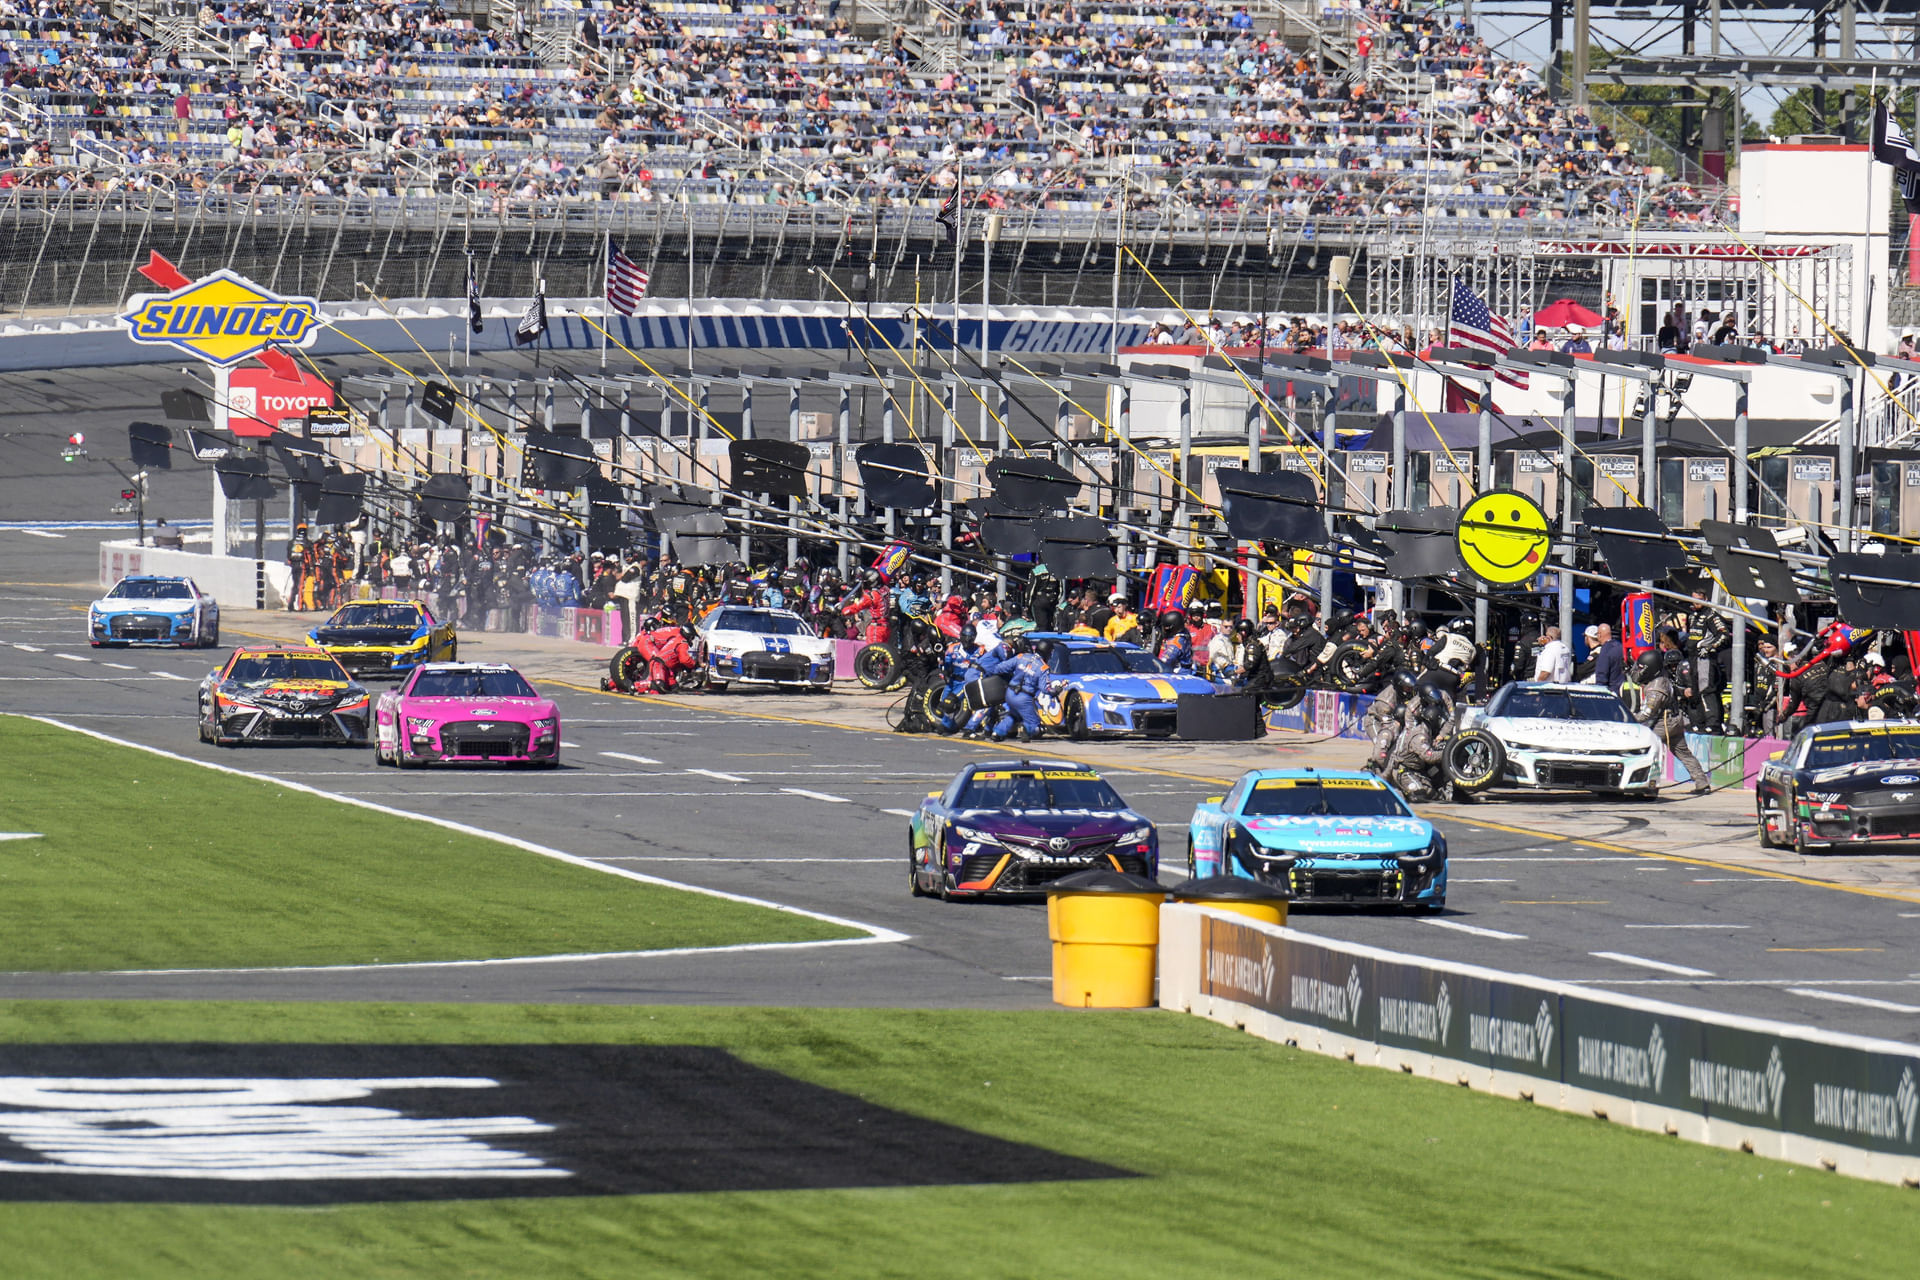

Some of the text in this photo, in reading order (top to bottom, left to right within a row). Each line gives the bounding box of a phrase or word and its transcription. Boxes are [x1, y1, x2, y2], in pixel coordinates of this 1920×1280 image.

[141, 305, 308, 336] SUNOCO
[1001, 320, 1152, 353] CHARLOT
[261, 396, 328, 411] TOYOTA
[1206, 949, 1262, 997] BANK OF AMERICA
[1291, 975, 1347, 1022] BANK OF AMERICA
[1380, 996, 1437, 1042] BANK OF AMERICA
[1470, 1013, 1535, 1062] BANK OF AMERICA
[1578, 1036, 1649, 1088] BANK OF AMERICA
[1690, 1058, 1768, 1115] BANK OF AMERICA
[1814, 1083, 1898, 1139] BANK OF AMERICA
